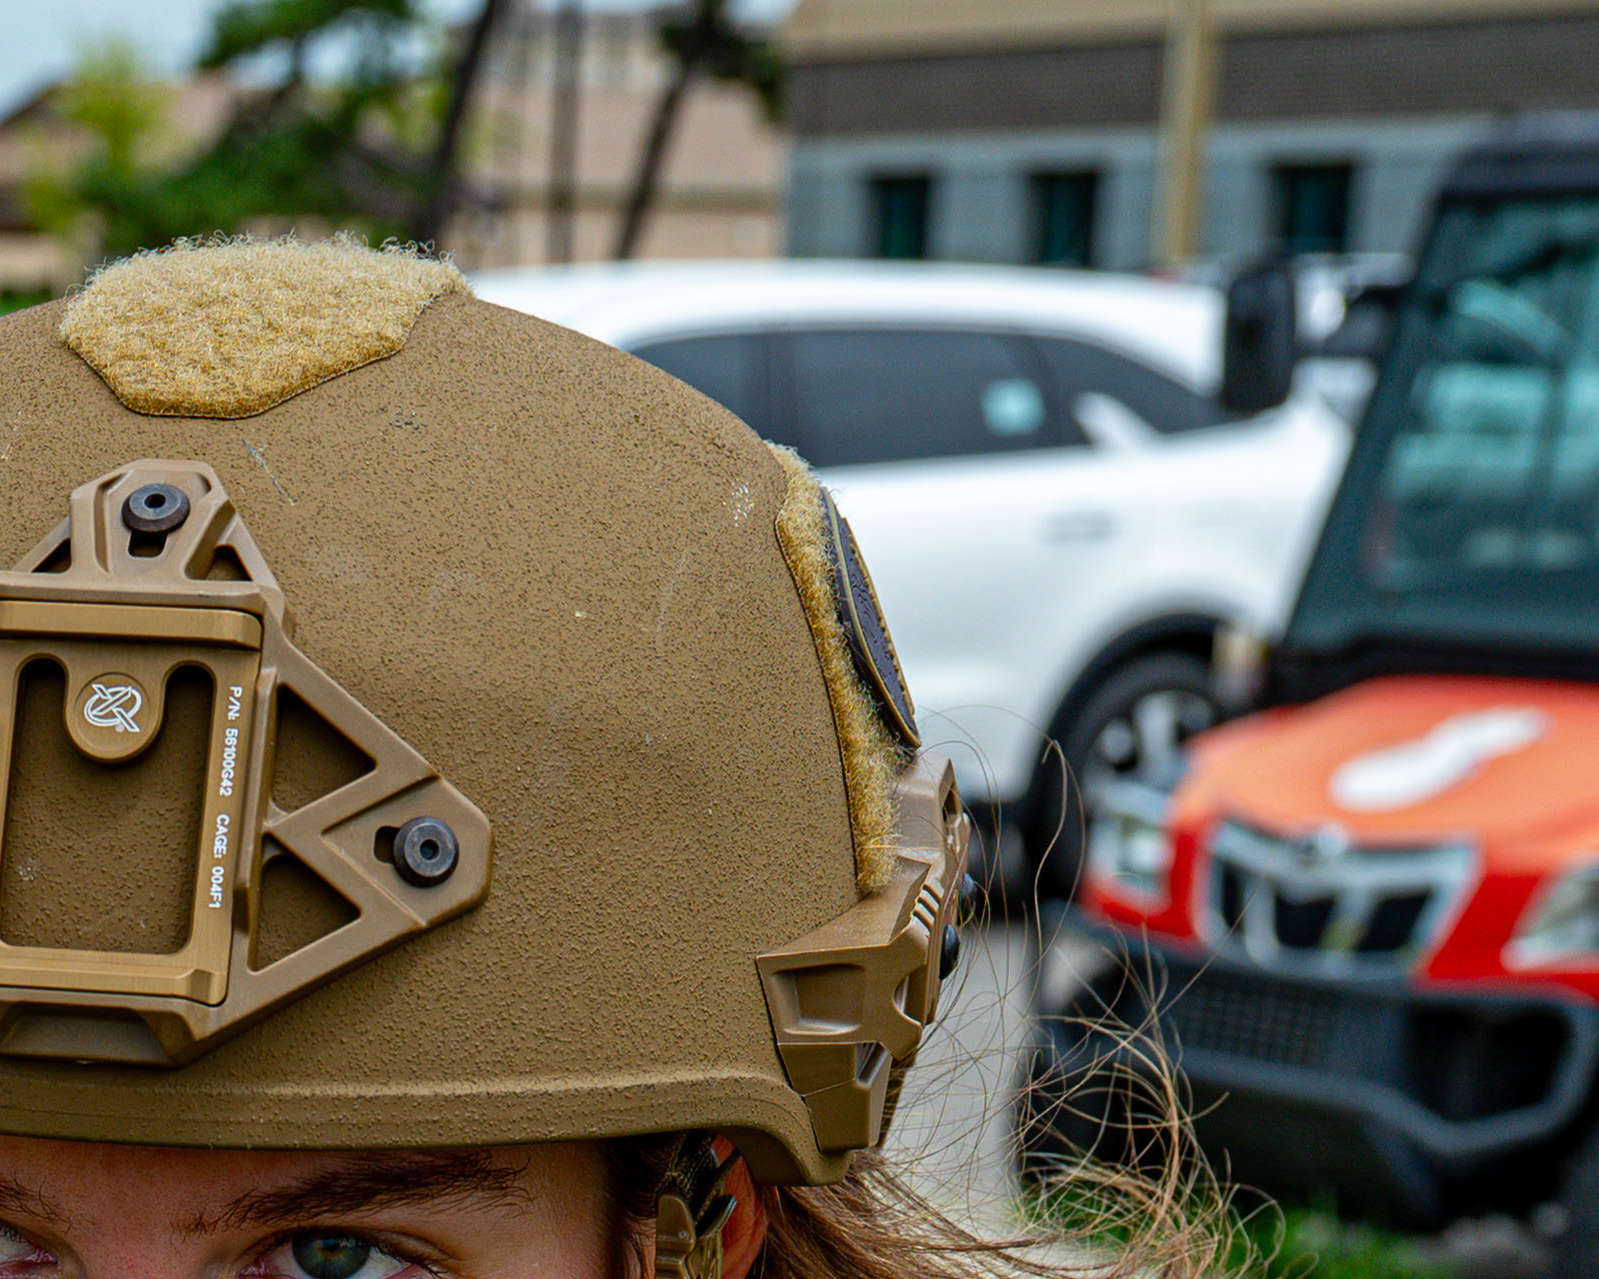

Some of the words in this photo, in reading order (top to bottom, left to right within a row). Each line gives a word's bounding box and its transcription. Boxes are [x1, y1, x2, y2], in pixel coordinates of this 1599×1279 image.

[228, 685, 243, 720] P/N:
[219, 728, 239, 797] 56100G42
[213, 813, 230, 859] CAGE:
[208, 866, 225, 909] 004F1
